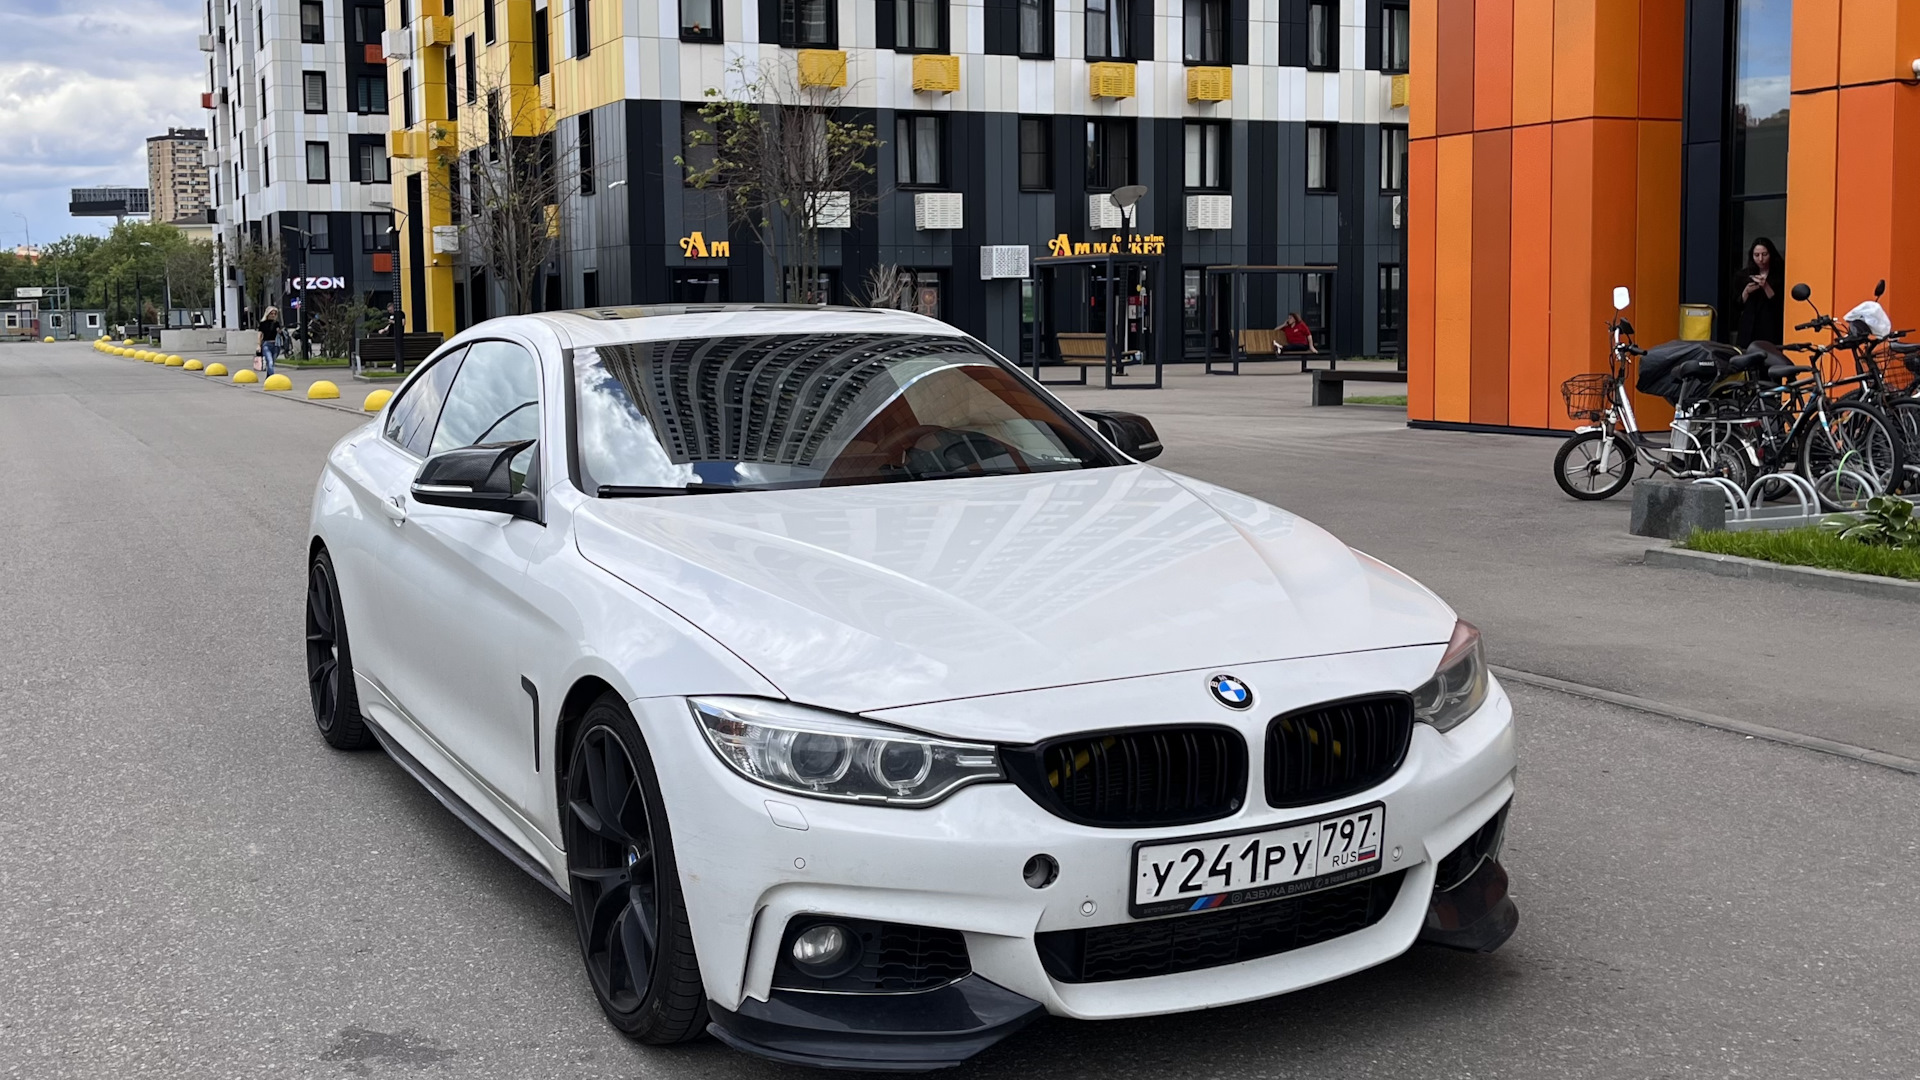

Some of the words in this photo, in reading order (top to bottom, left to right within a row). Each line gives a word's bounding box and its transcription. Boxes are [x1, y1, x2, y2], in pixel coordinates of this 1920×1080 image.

[1143, 233, 1164, 242] wine
[292, 276, 345, 290] OZON
[1152, 839, 1313, 897] У241РУ
[1322, 813, 1373, 857] 797
[1332, 851, 1358, 868] RUS
[1244, 886, 1286, 901] АЗБУКА
[1287, 881, 1313, 895] BMW
